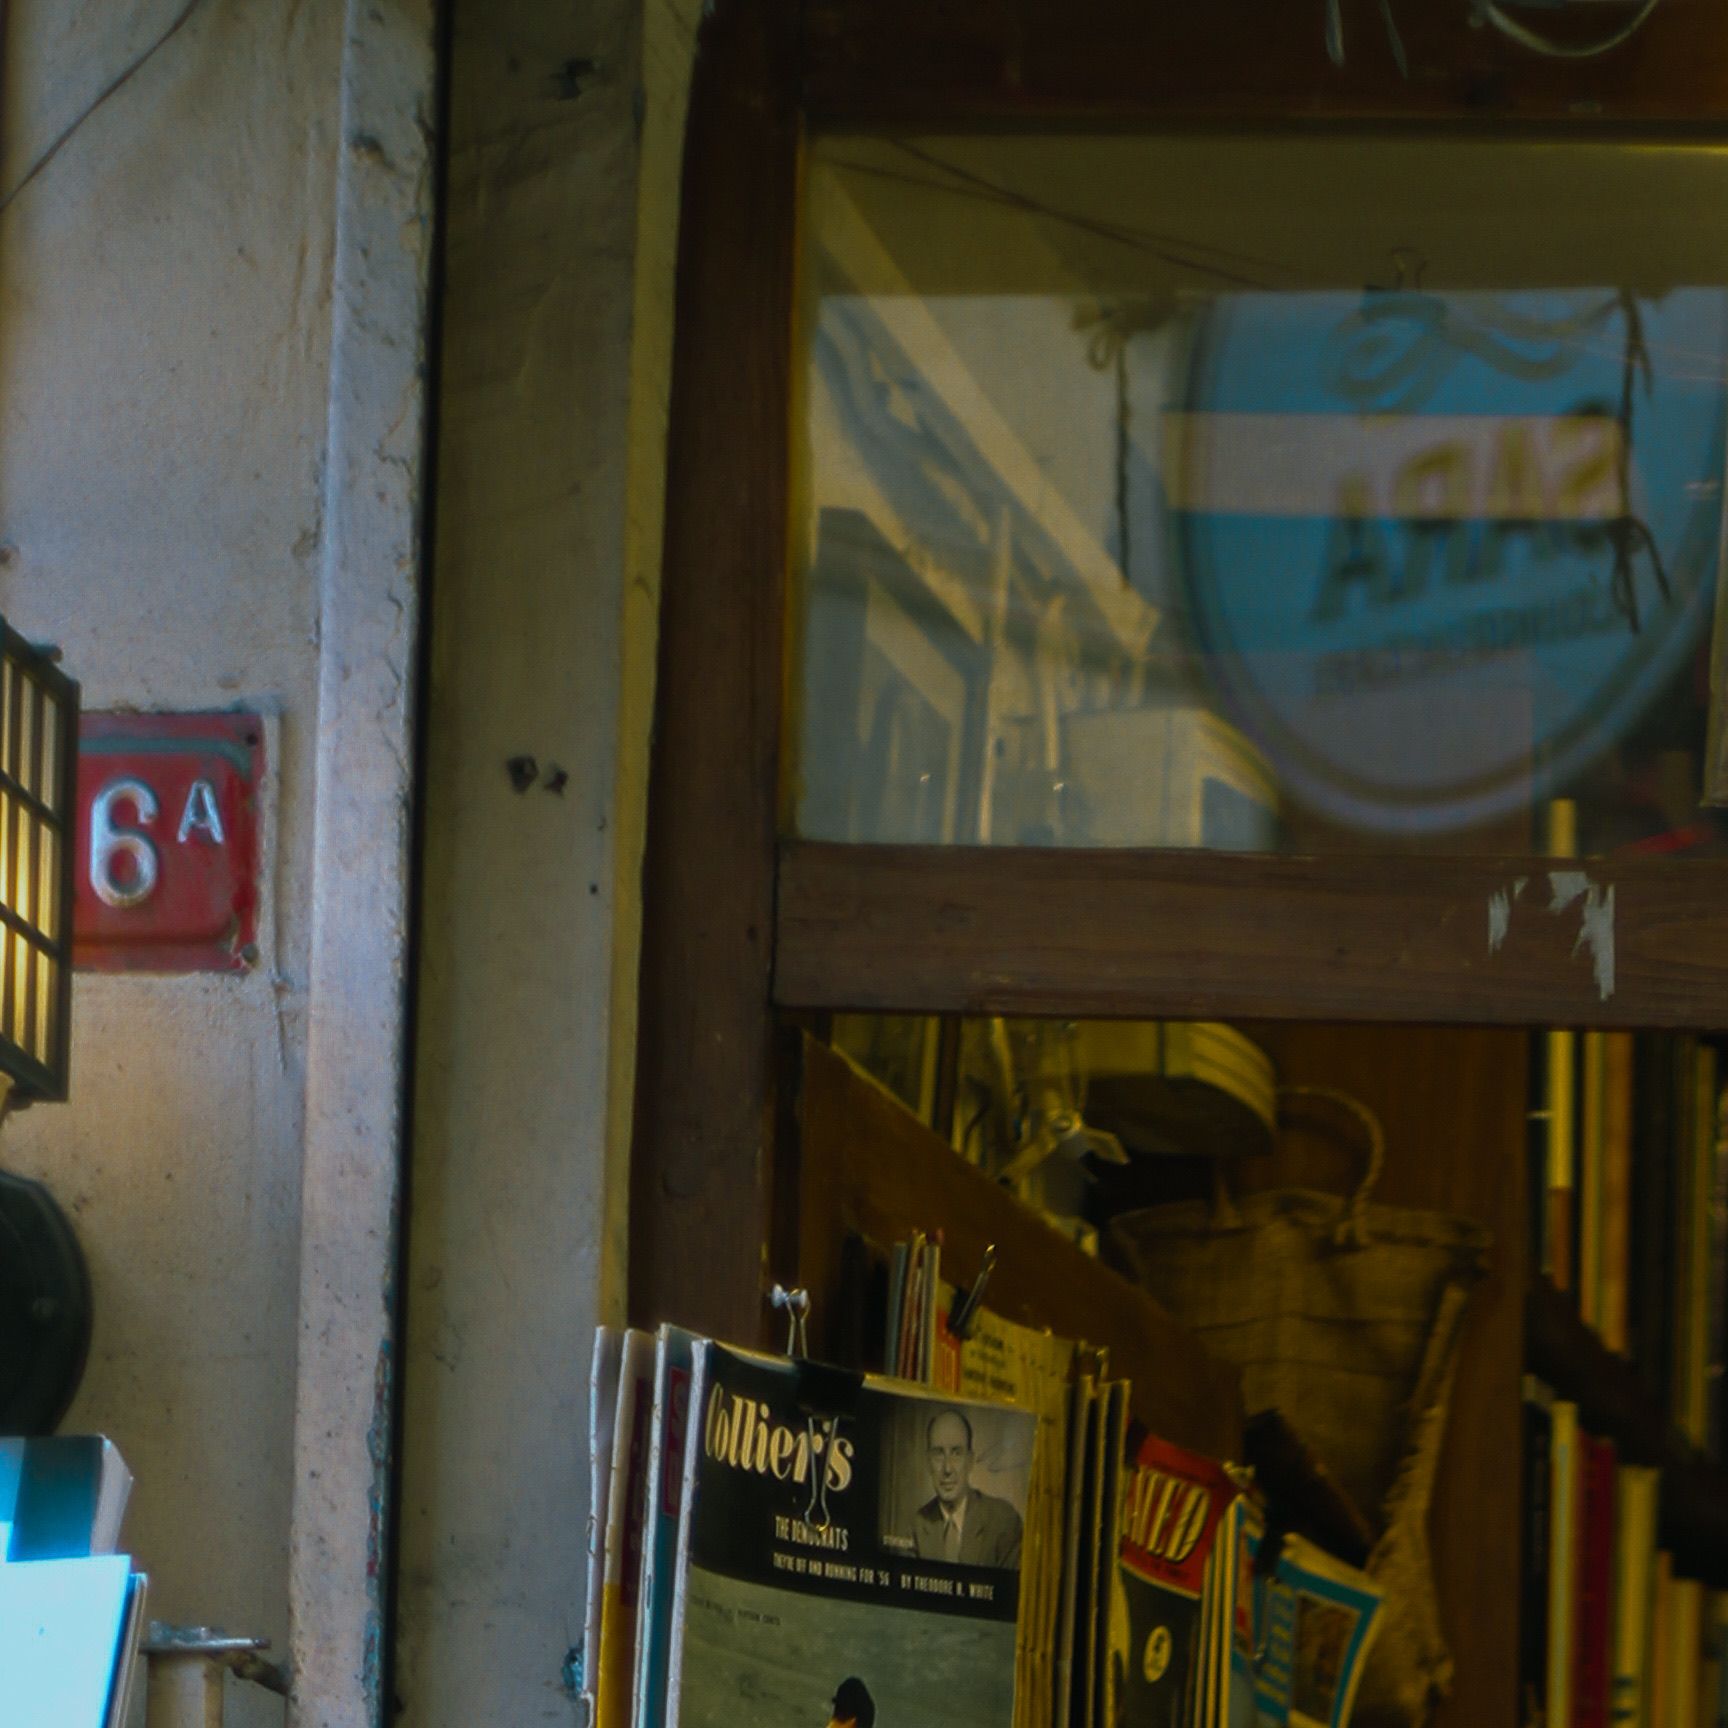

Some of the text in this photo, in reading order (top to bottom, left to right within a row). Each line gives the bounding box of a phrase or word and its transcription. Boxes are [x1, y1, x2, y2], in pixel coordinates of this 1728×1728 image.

[90, 777, 225, 907] 6A
[704, 1381, 856, 1492] Collier's
[775, 1515, 790, 1541] THE
[809, 1558, 822, 1576] AND
[825, 1562, 857, 1582] RUNNING
[859, 1566, 875, 1584] FOR
[901, 1573, 912, 1589] BY
[914, 1575, 954, 1596] THEODORE
[969, 1582, 995, 1601] WHITE
